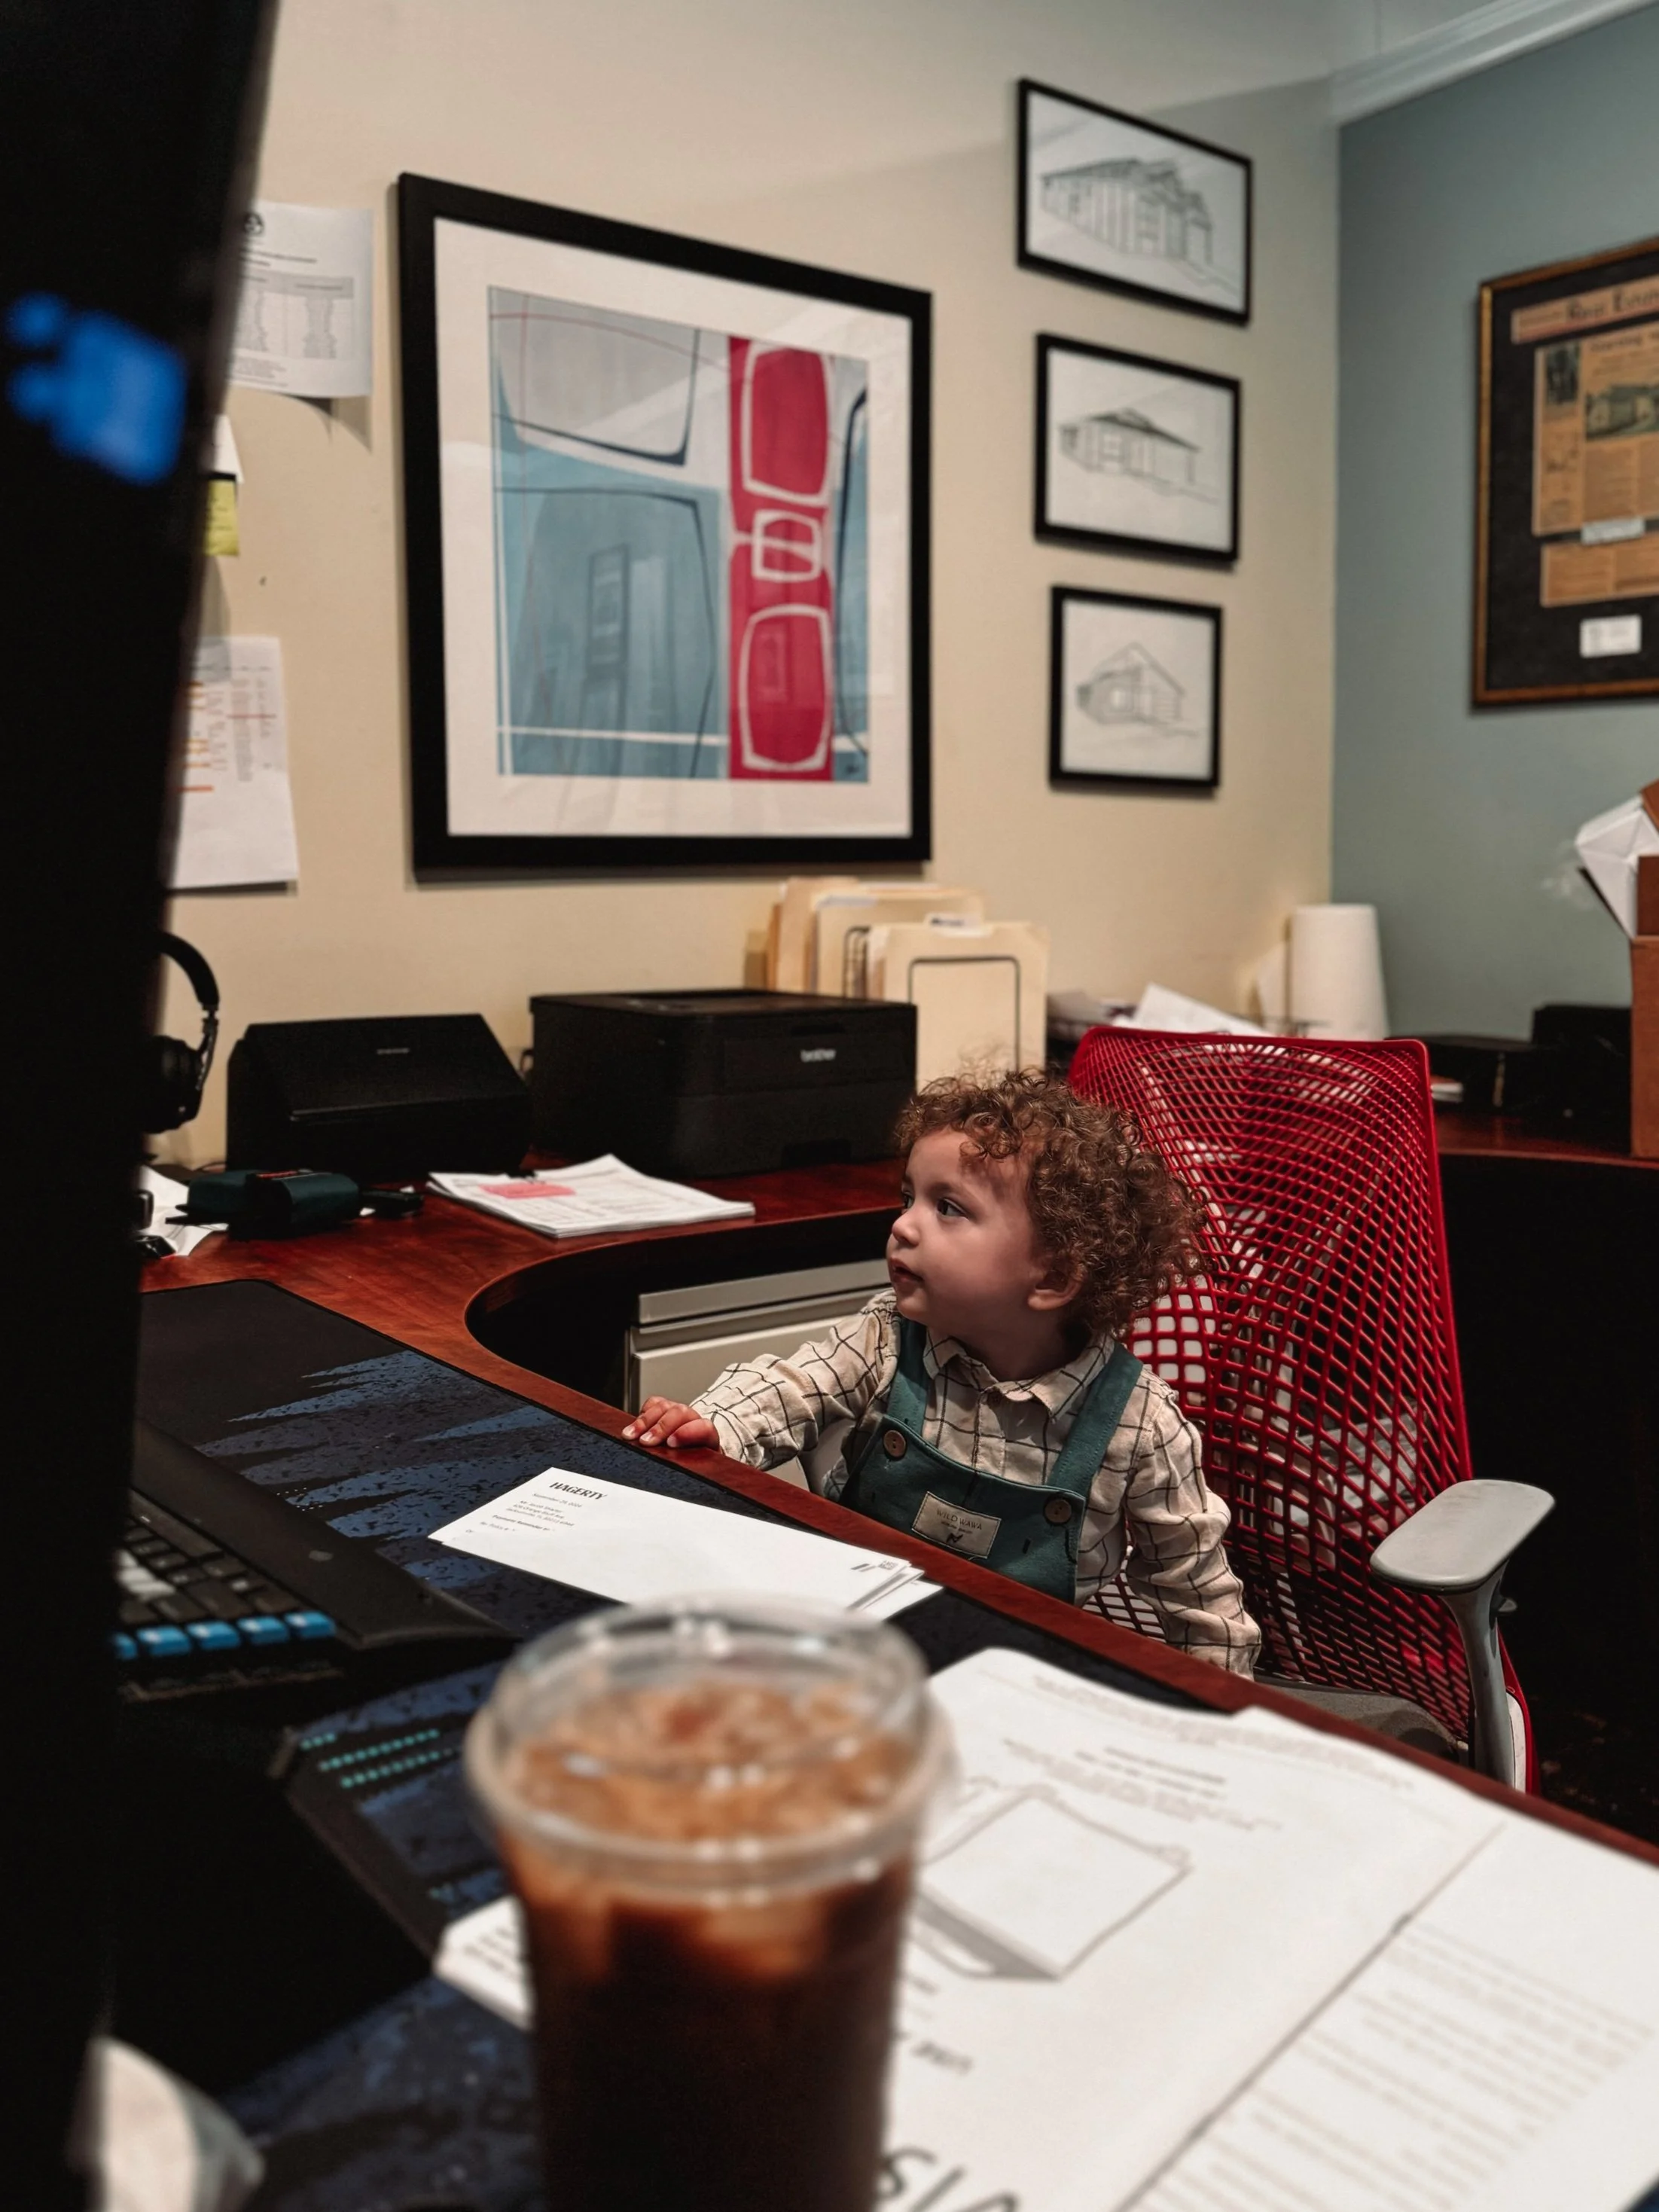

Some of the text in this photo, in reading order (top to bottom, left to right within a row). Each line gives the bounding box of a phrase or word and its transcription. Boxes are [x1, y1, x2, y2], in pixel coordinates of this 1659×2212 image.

[549, 1481, 608, 1500] HAGERTY
[937, 1509, 958, 1521] WILD
[959, 1518, 982, 1530] WAWA
